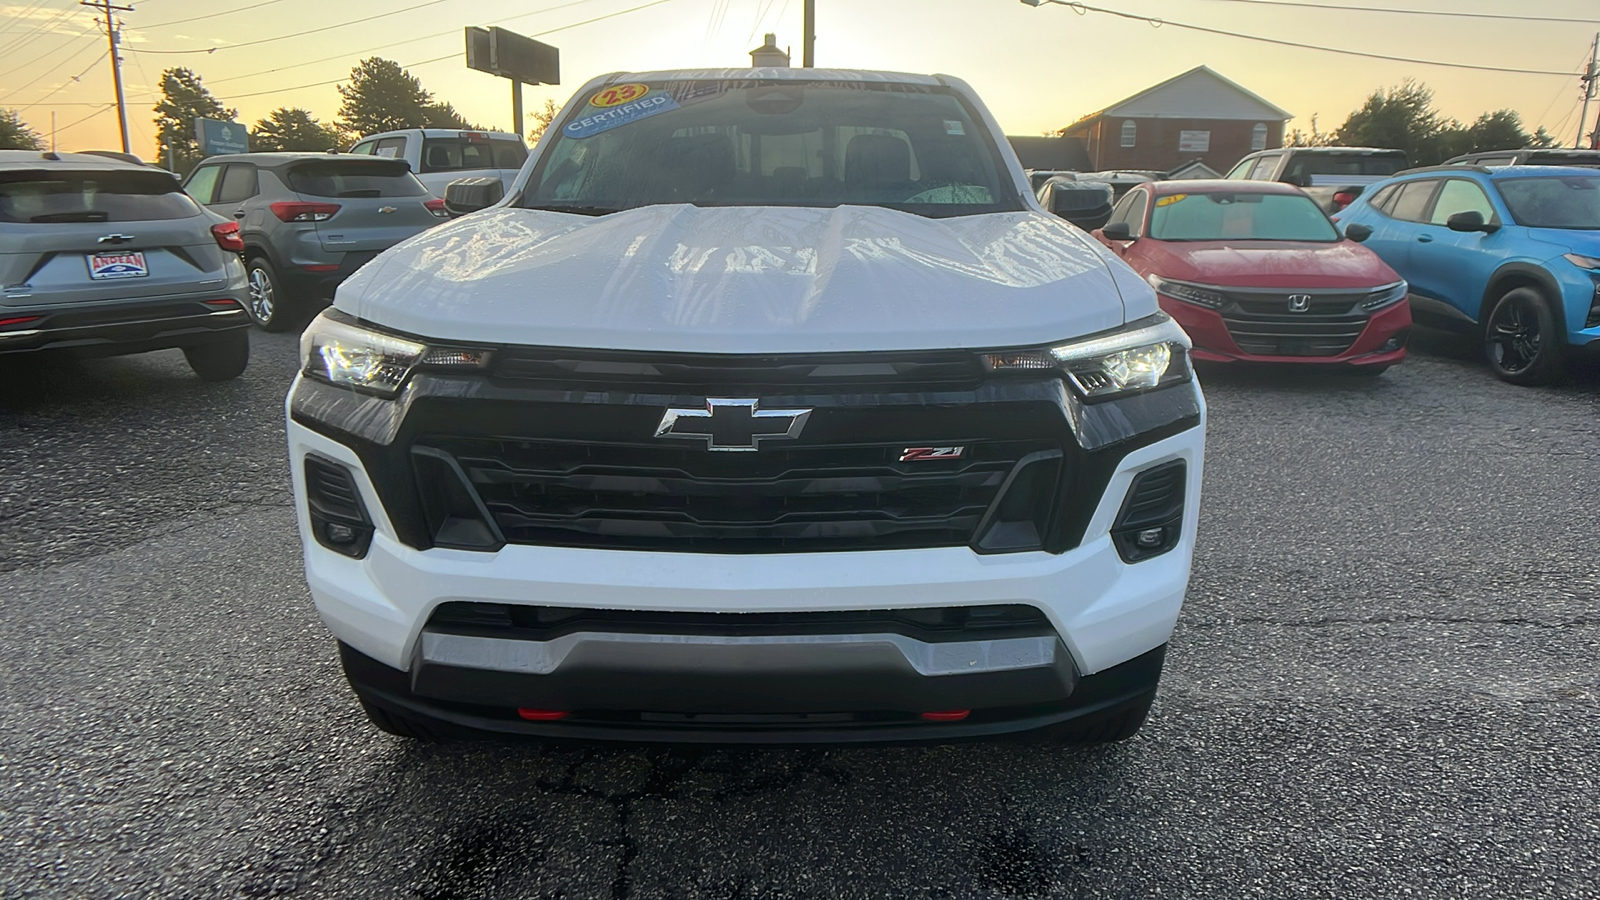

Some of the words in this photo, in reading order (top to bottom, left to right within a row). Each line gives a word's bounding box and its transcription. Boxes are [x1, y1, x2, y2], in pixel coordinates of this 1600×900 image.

[601, 84, 638, 106] 23
[567, 96, 667, 132] CERTIFIED
[92, 254, 144, 271] ANDEAN
